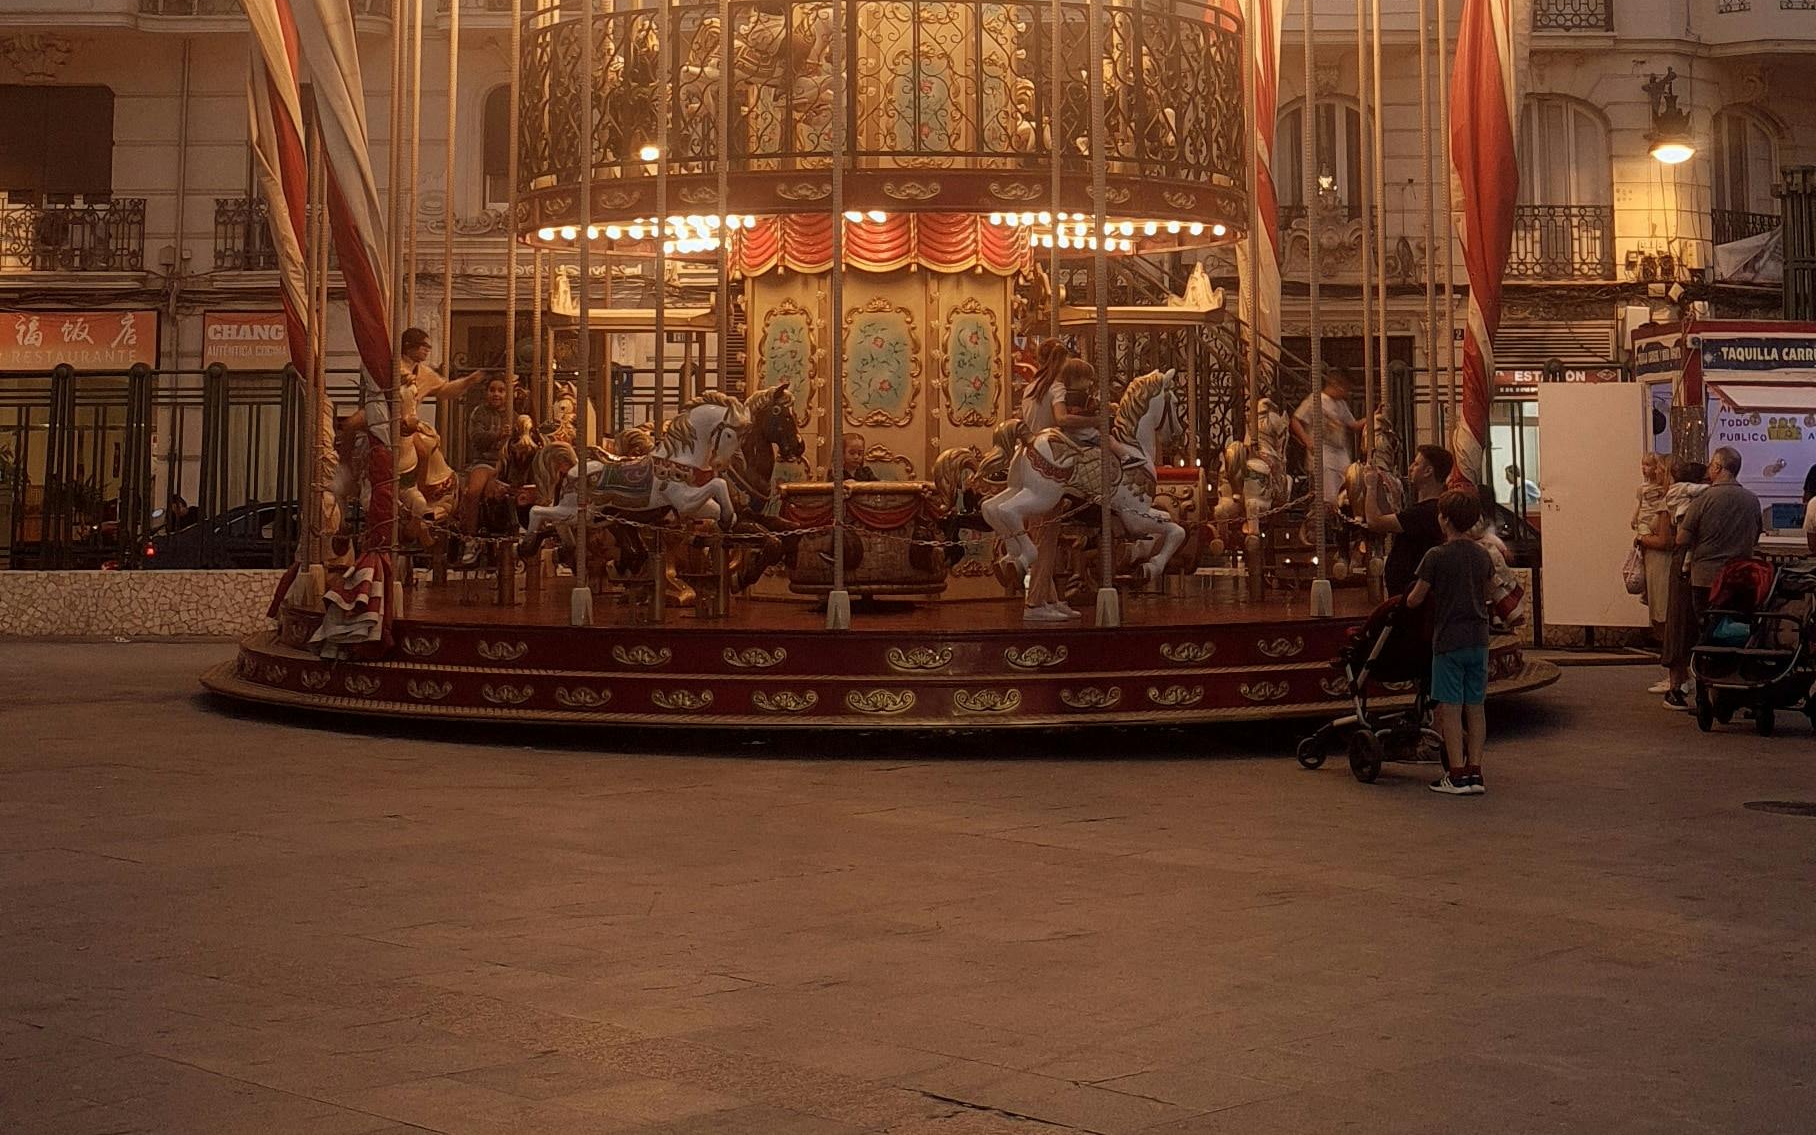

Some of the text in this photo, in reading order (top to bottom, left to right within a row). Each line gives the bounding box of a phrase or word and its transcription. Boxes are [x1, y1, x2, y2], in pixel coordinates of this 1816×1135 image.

[208, 324, 285, 341] CHANG
[11, 349, 137, 364] RESTAURANTE
[1721, 346, 1779, 362] TAQUILLA
[1720, 432, 1767, 442] PUBLICO
